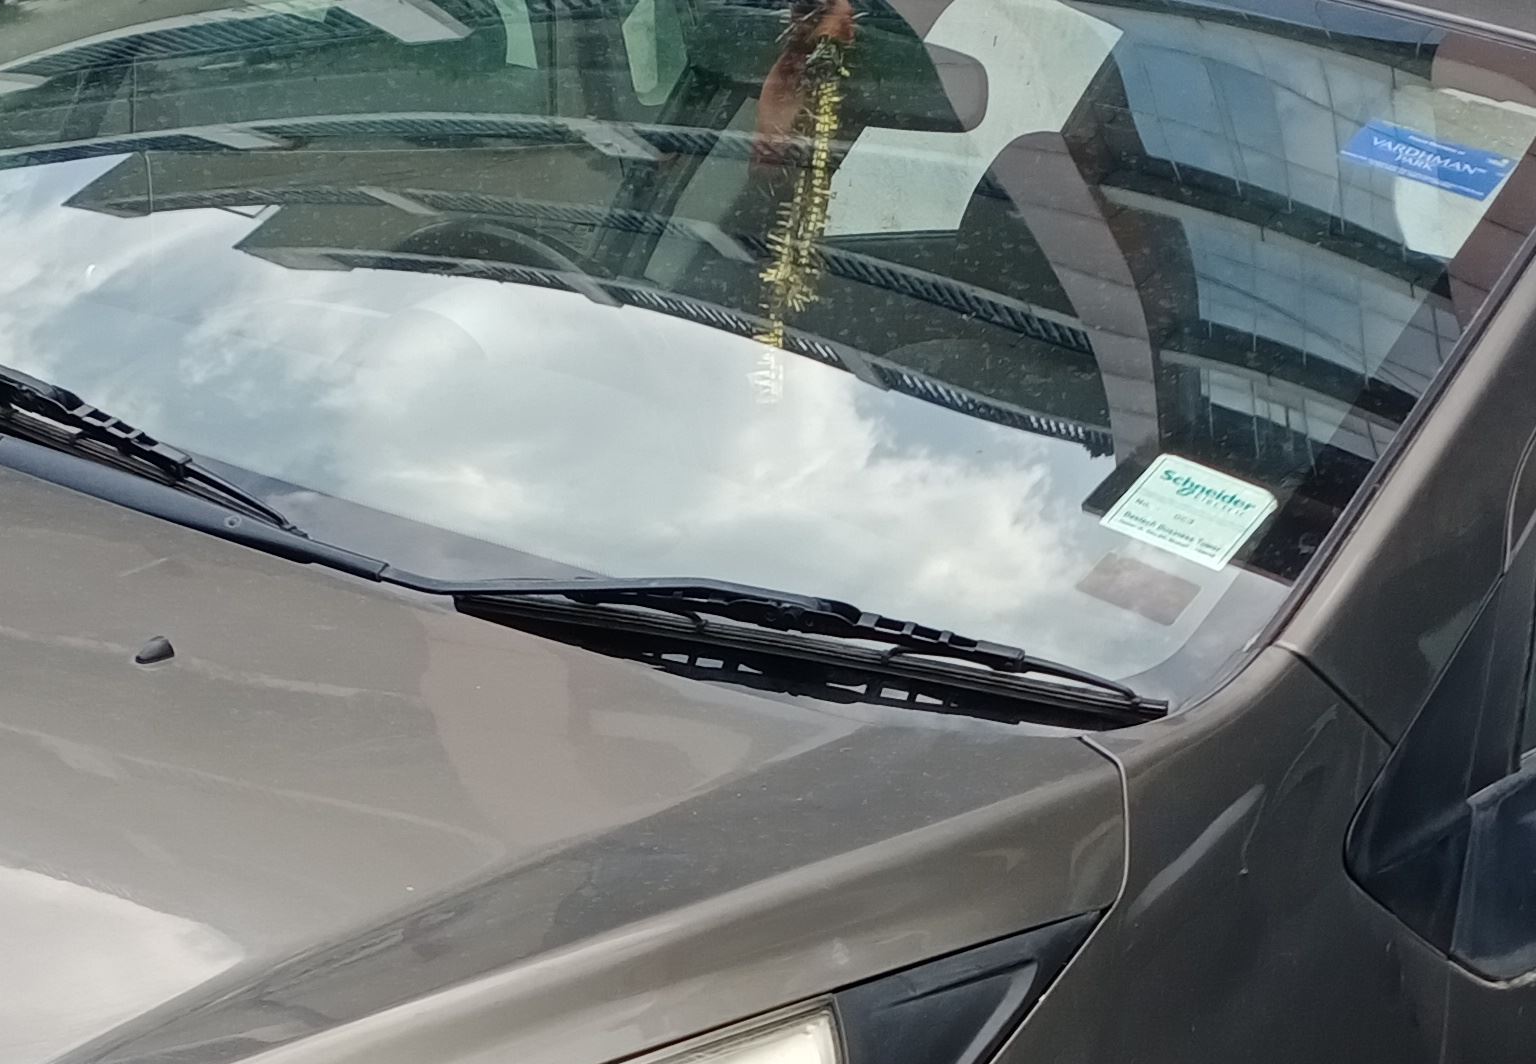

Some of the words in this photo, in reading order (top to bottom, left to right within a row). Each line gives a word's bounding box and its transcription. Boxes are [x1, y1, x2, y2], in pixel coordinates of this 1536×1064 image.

[1371, 135, 1477, 175] VARDHMAN
[1395, 149, 1434, 172] PARK
[1159, 468, 1256, 512] Schneider
